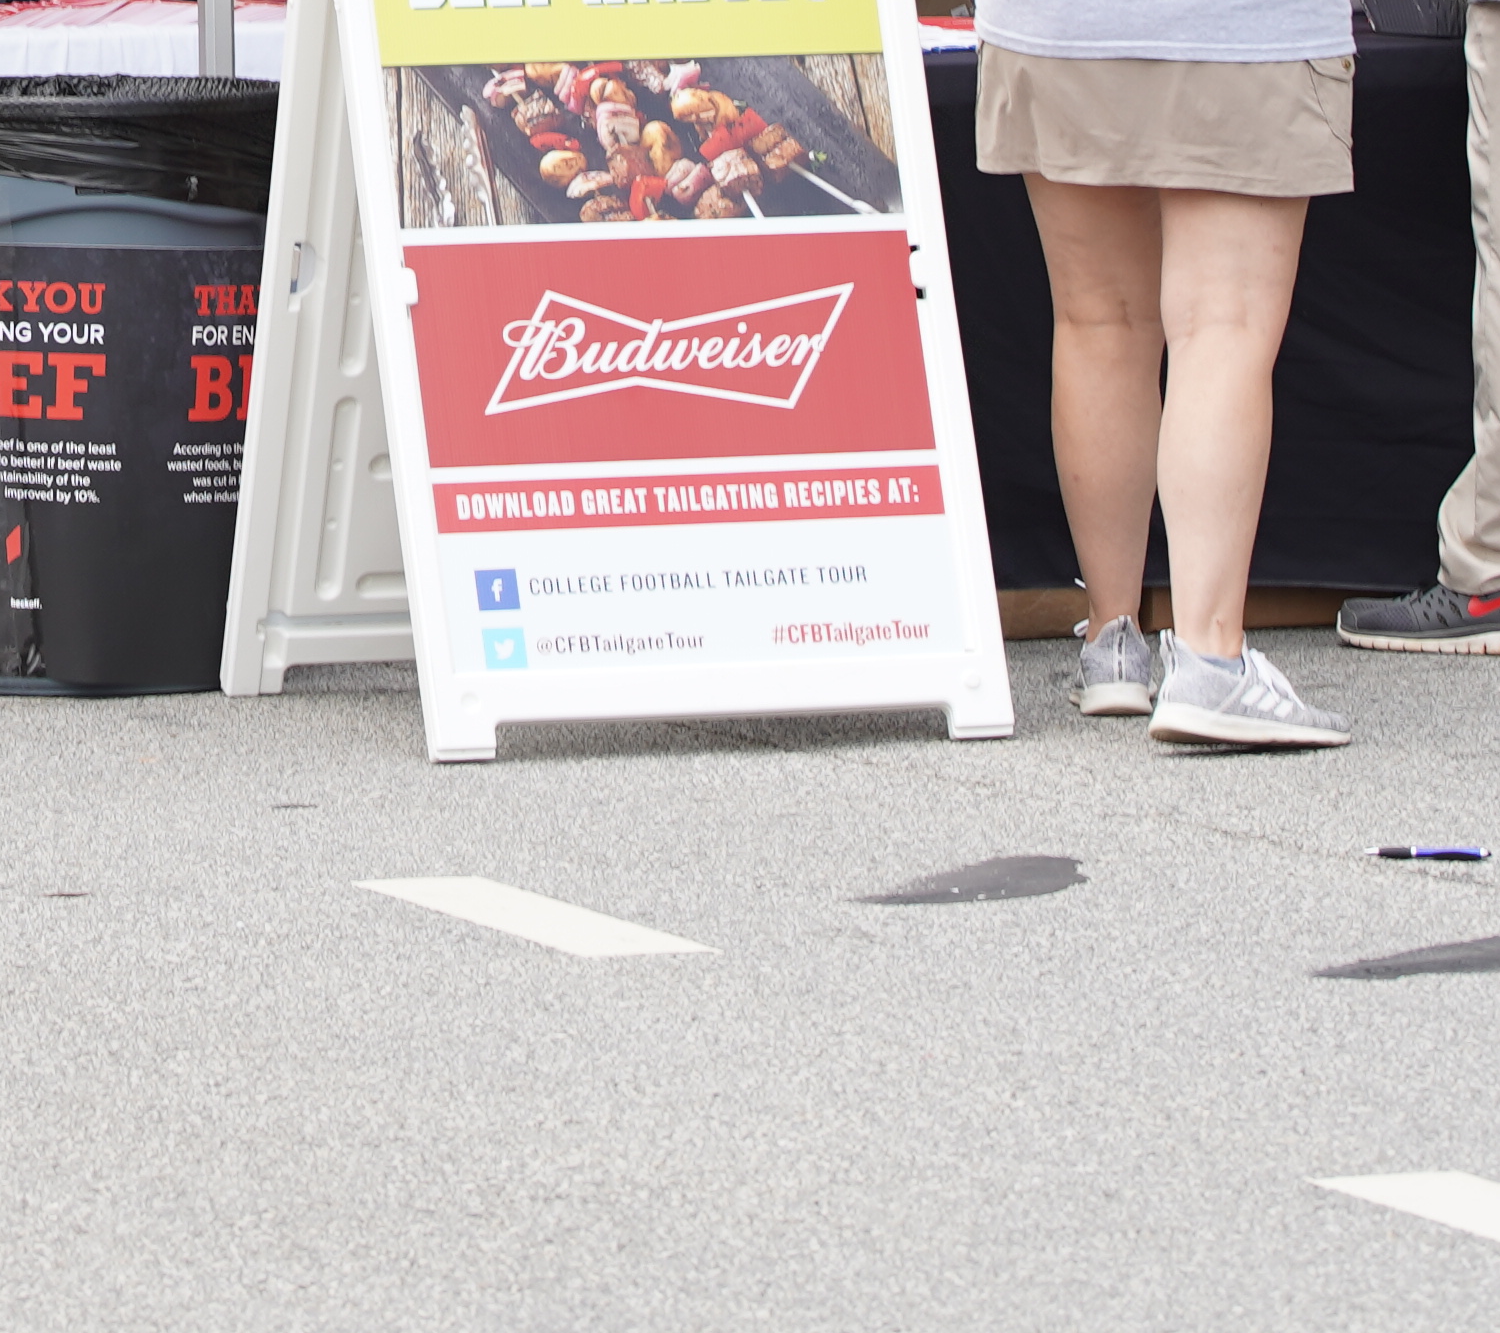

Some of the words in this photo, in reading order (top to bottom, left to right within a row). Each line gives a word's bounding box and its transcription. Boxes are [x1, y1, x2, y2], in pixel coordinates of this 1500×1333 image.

[20, 281, 107, 315] YOU
[38, 322, 106, 347] YOUR
[503, 318, 825, 382] Budweiser
[455, 490, 575, 521] DOWNLOAD
[581, 487, 647, 516] GREAT
[653, 484, 779, 513] TAILGATING
[783, 482, 882, 508] RECIPIES
[888, 482, 920, 504] AT:
[529, 575, 613, 596] COLLEGE
[620, 571, 717, 593] FOOTBALL
[723, 567, 810, 589] TAILGATE
[816, 564, 868, 584] TOUR
[536, 631, 705, 655] @CFBTailgateTour
[773, 620, 931, 646] #CFBTailgateTour
